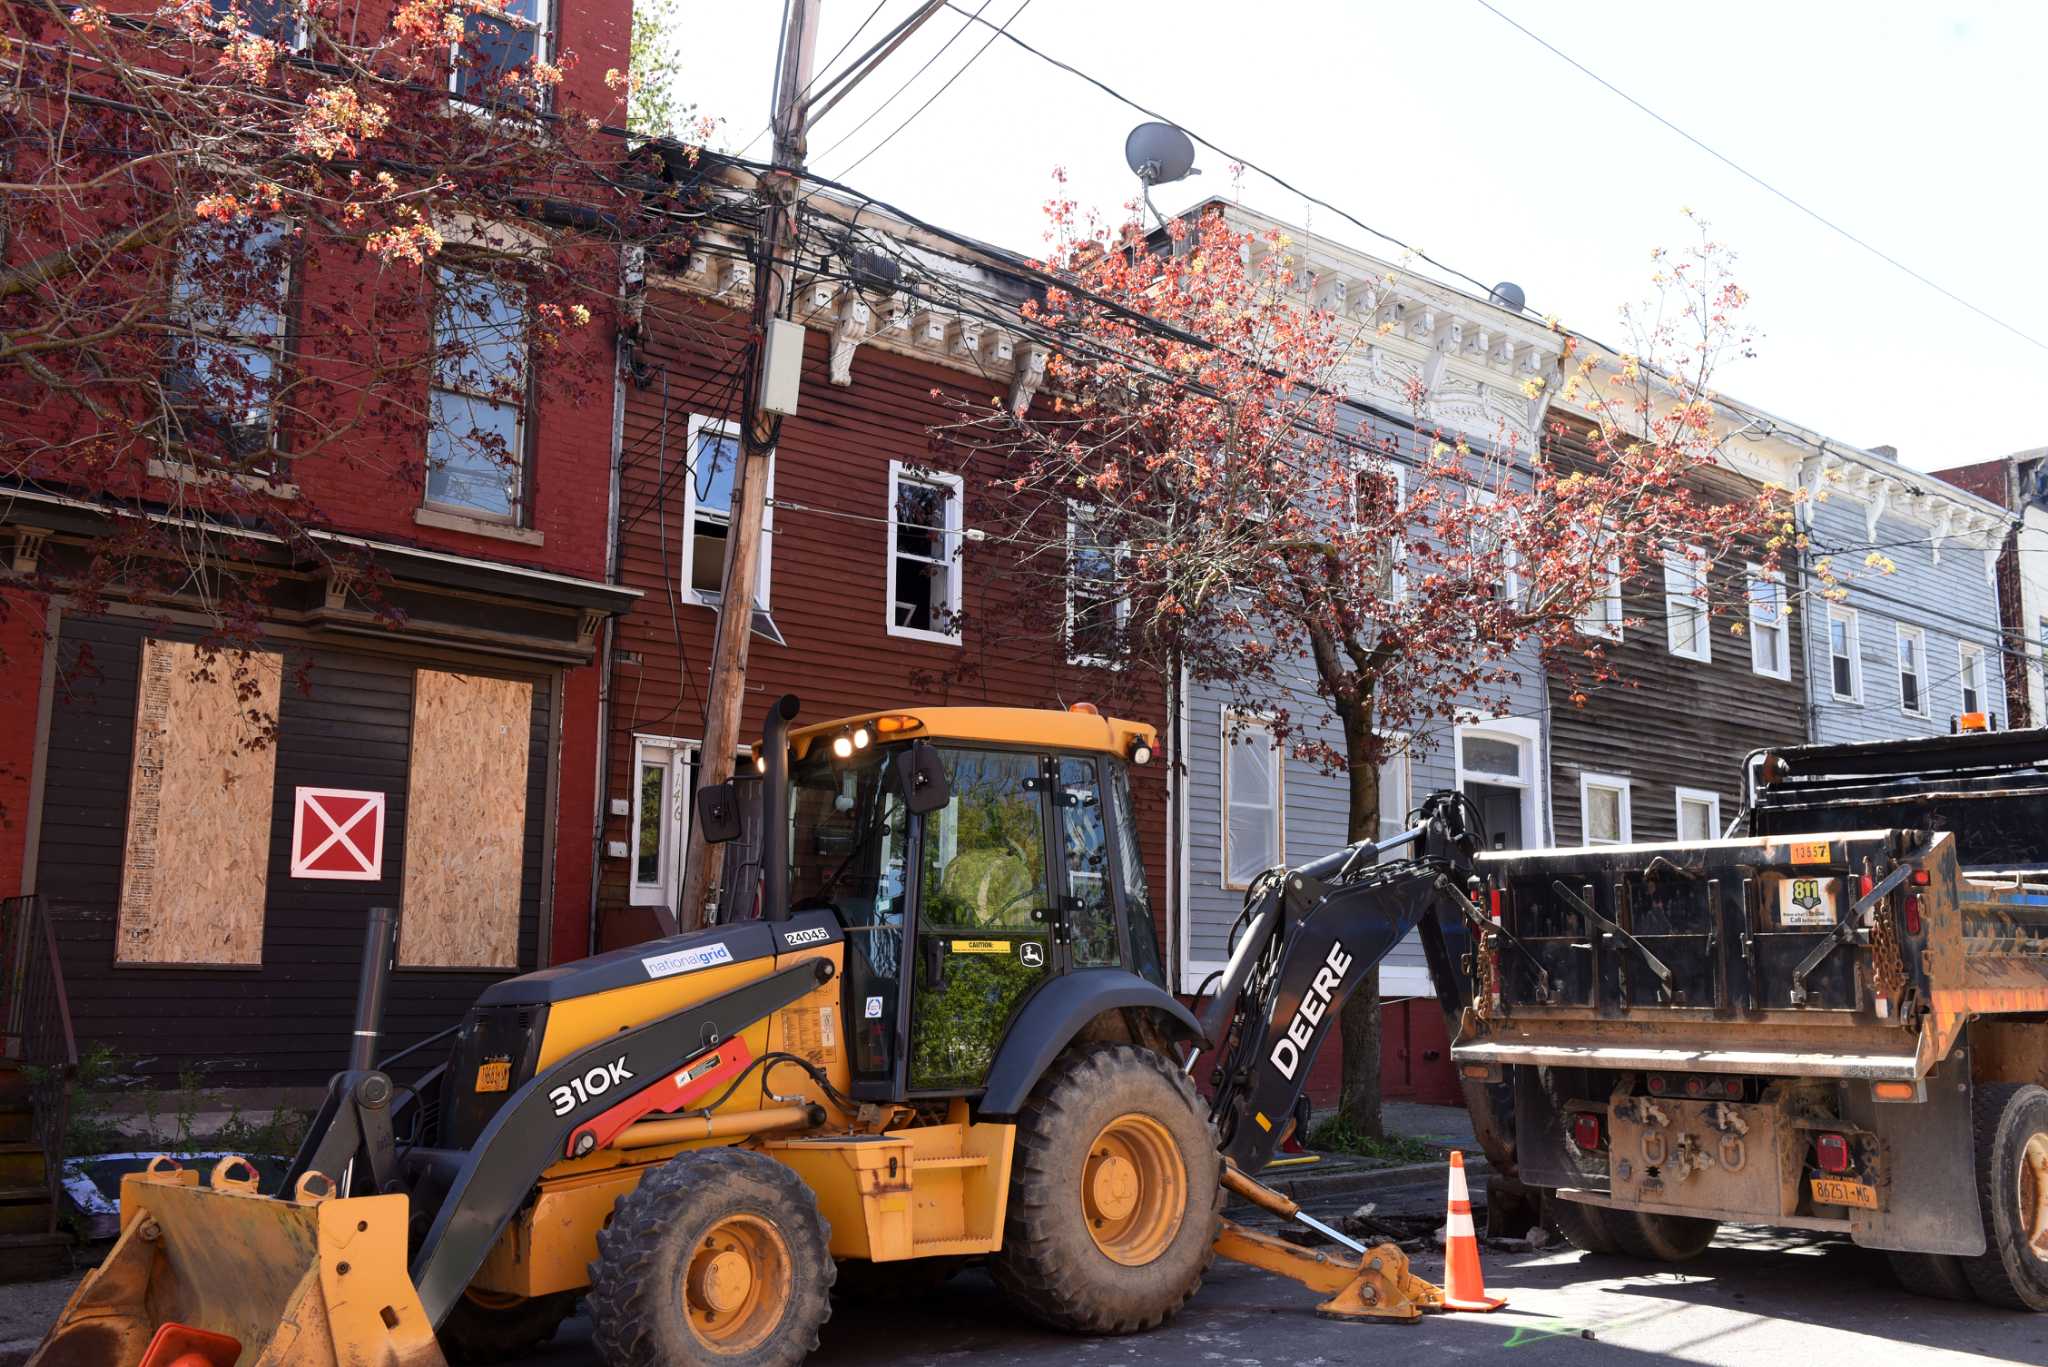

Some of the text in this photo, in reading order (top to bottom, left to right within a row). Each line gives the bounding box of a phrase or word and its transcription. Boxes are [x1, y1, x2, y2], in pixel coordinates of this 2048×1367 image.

[1794, 881, 1818, 899] 811
[786, 929, 828, 945] 24045
[649, 947, 729, 975] nationalgrid
[1270, 941, 1353, 1081] DEERE
[548, 1056, 634, 1117] 310K
